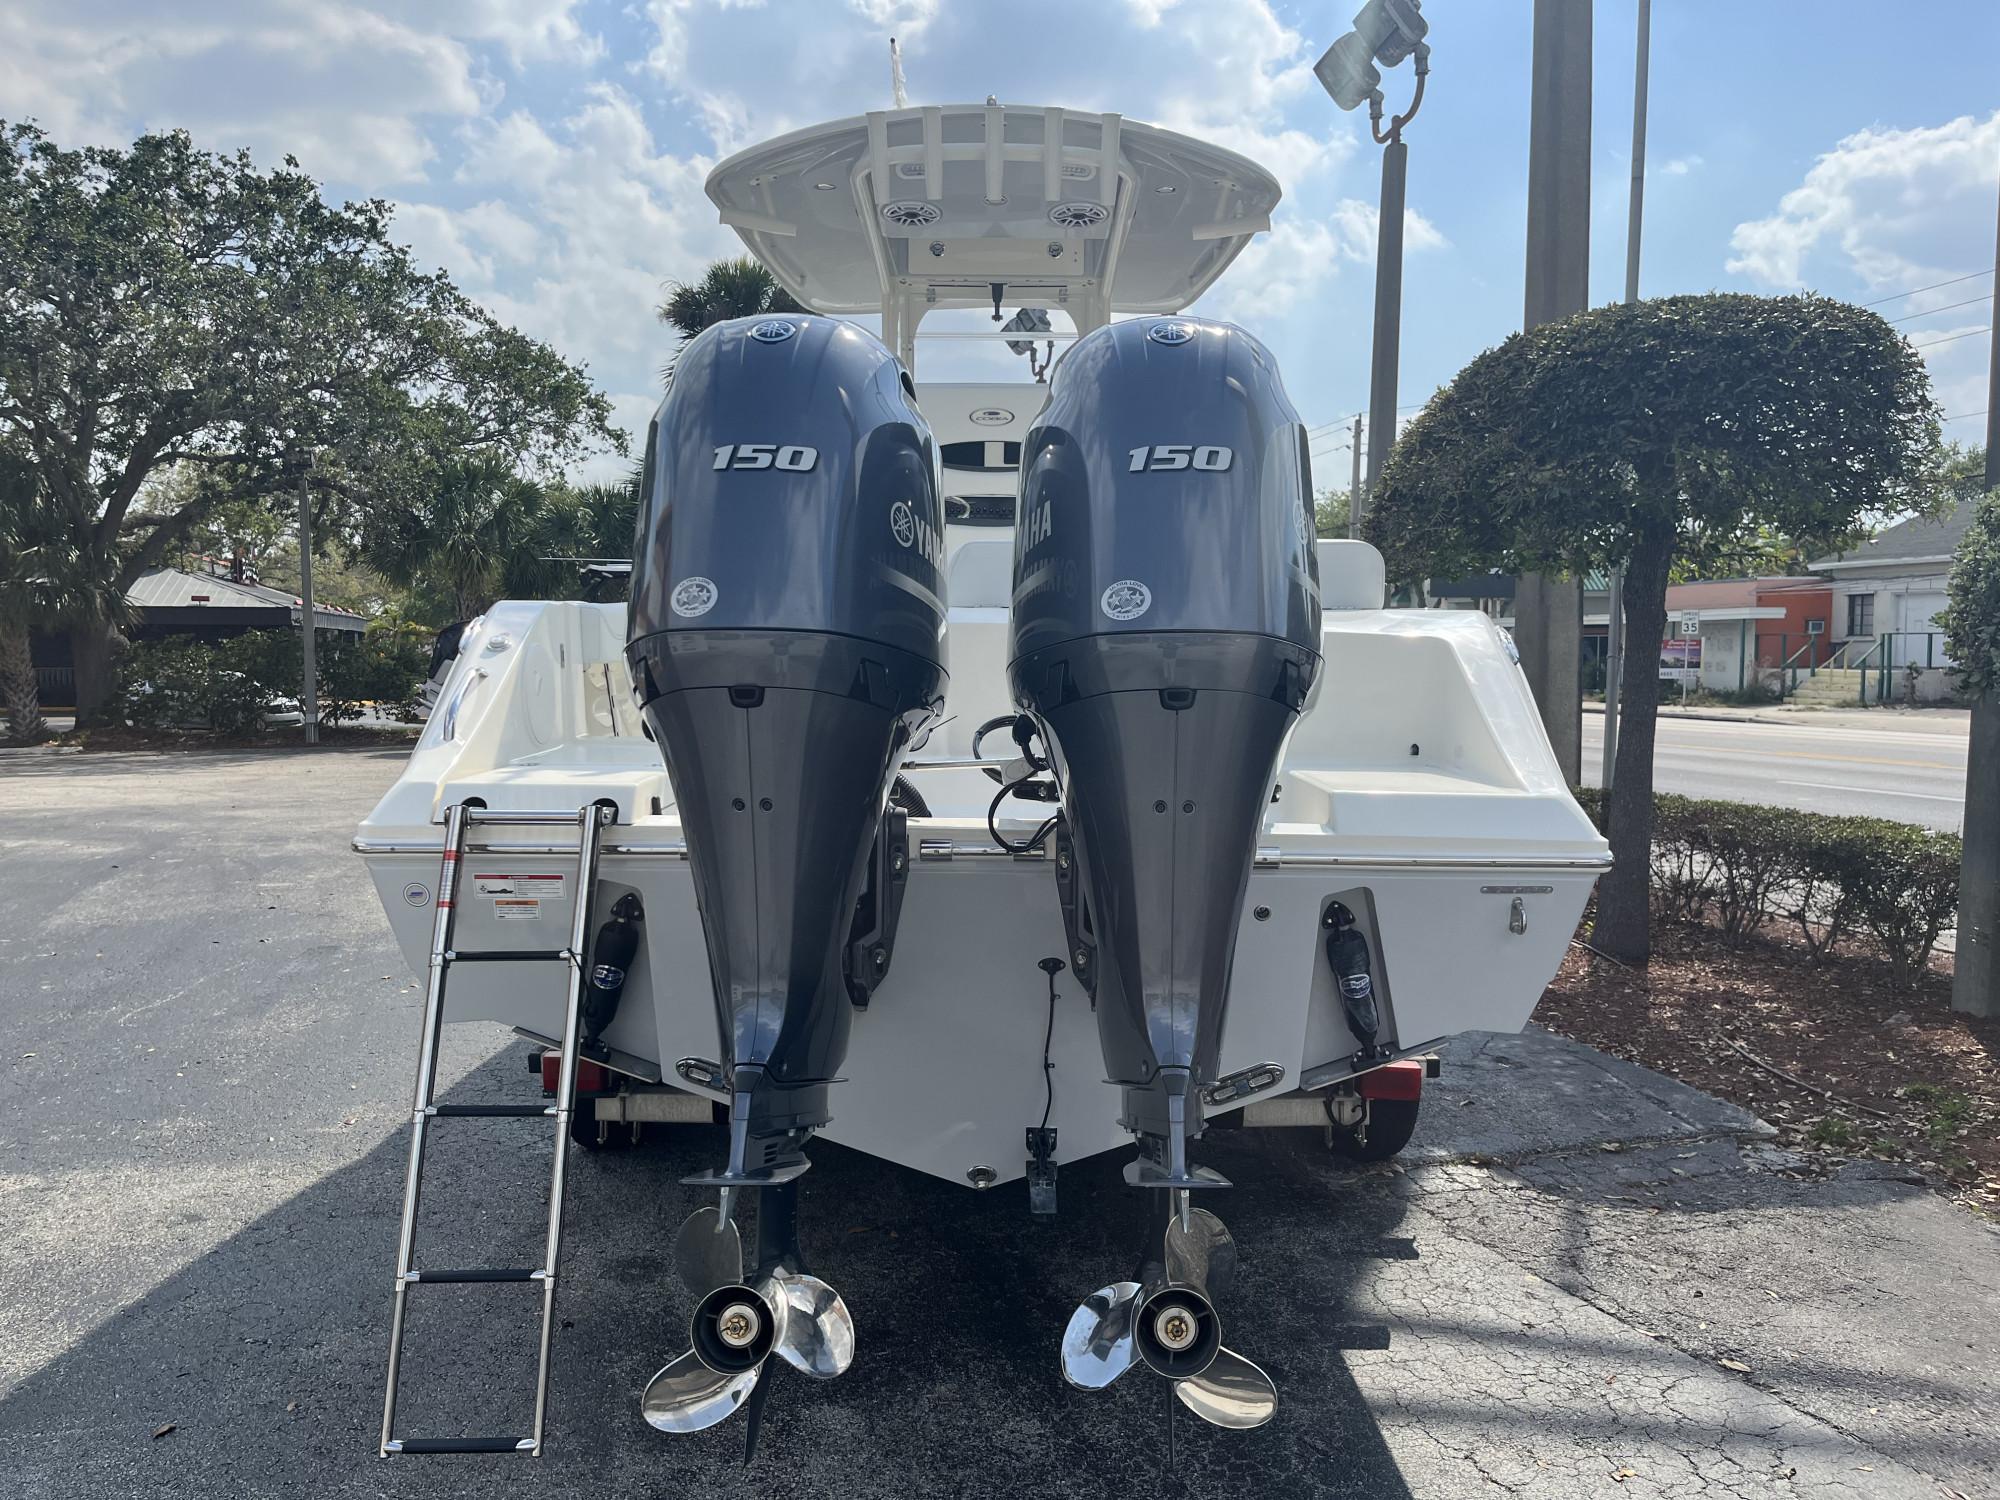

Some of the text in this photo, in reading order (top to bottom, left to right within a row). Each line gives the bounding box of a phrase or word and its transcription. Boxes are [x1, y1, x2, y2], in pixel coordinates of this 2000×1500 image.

[712, 444, 818, 471] 150
[1128, 445, 1233, 472] 150
[1683, 622, 1697, 632] 35
